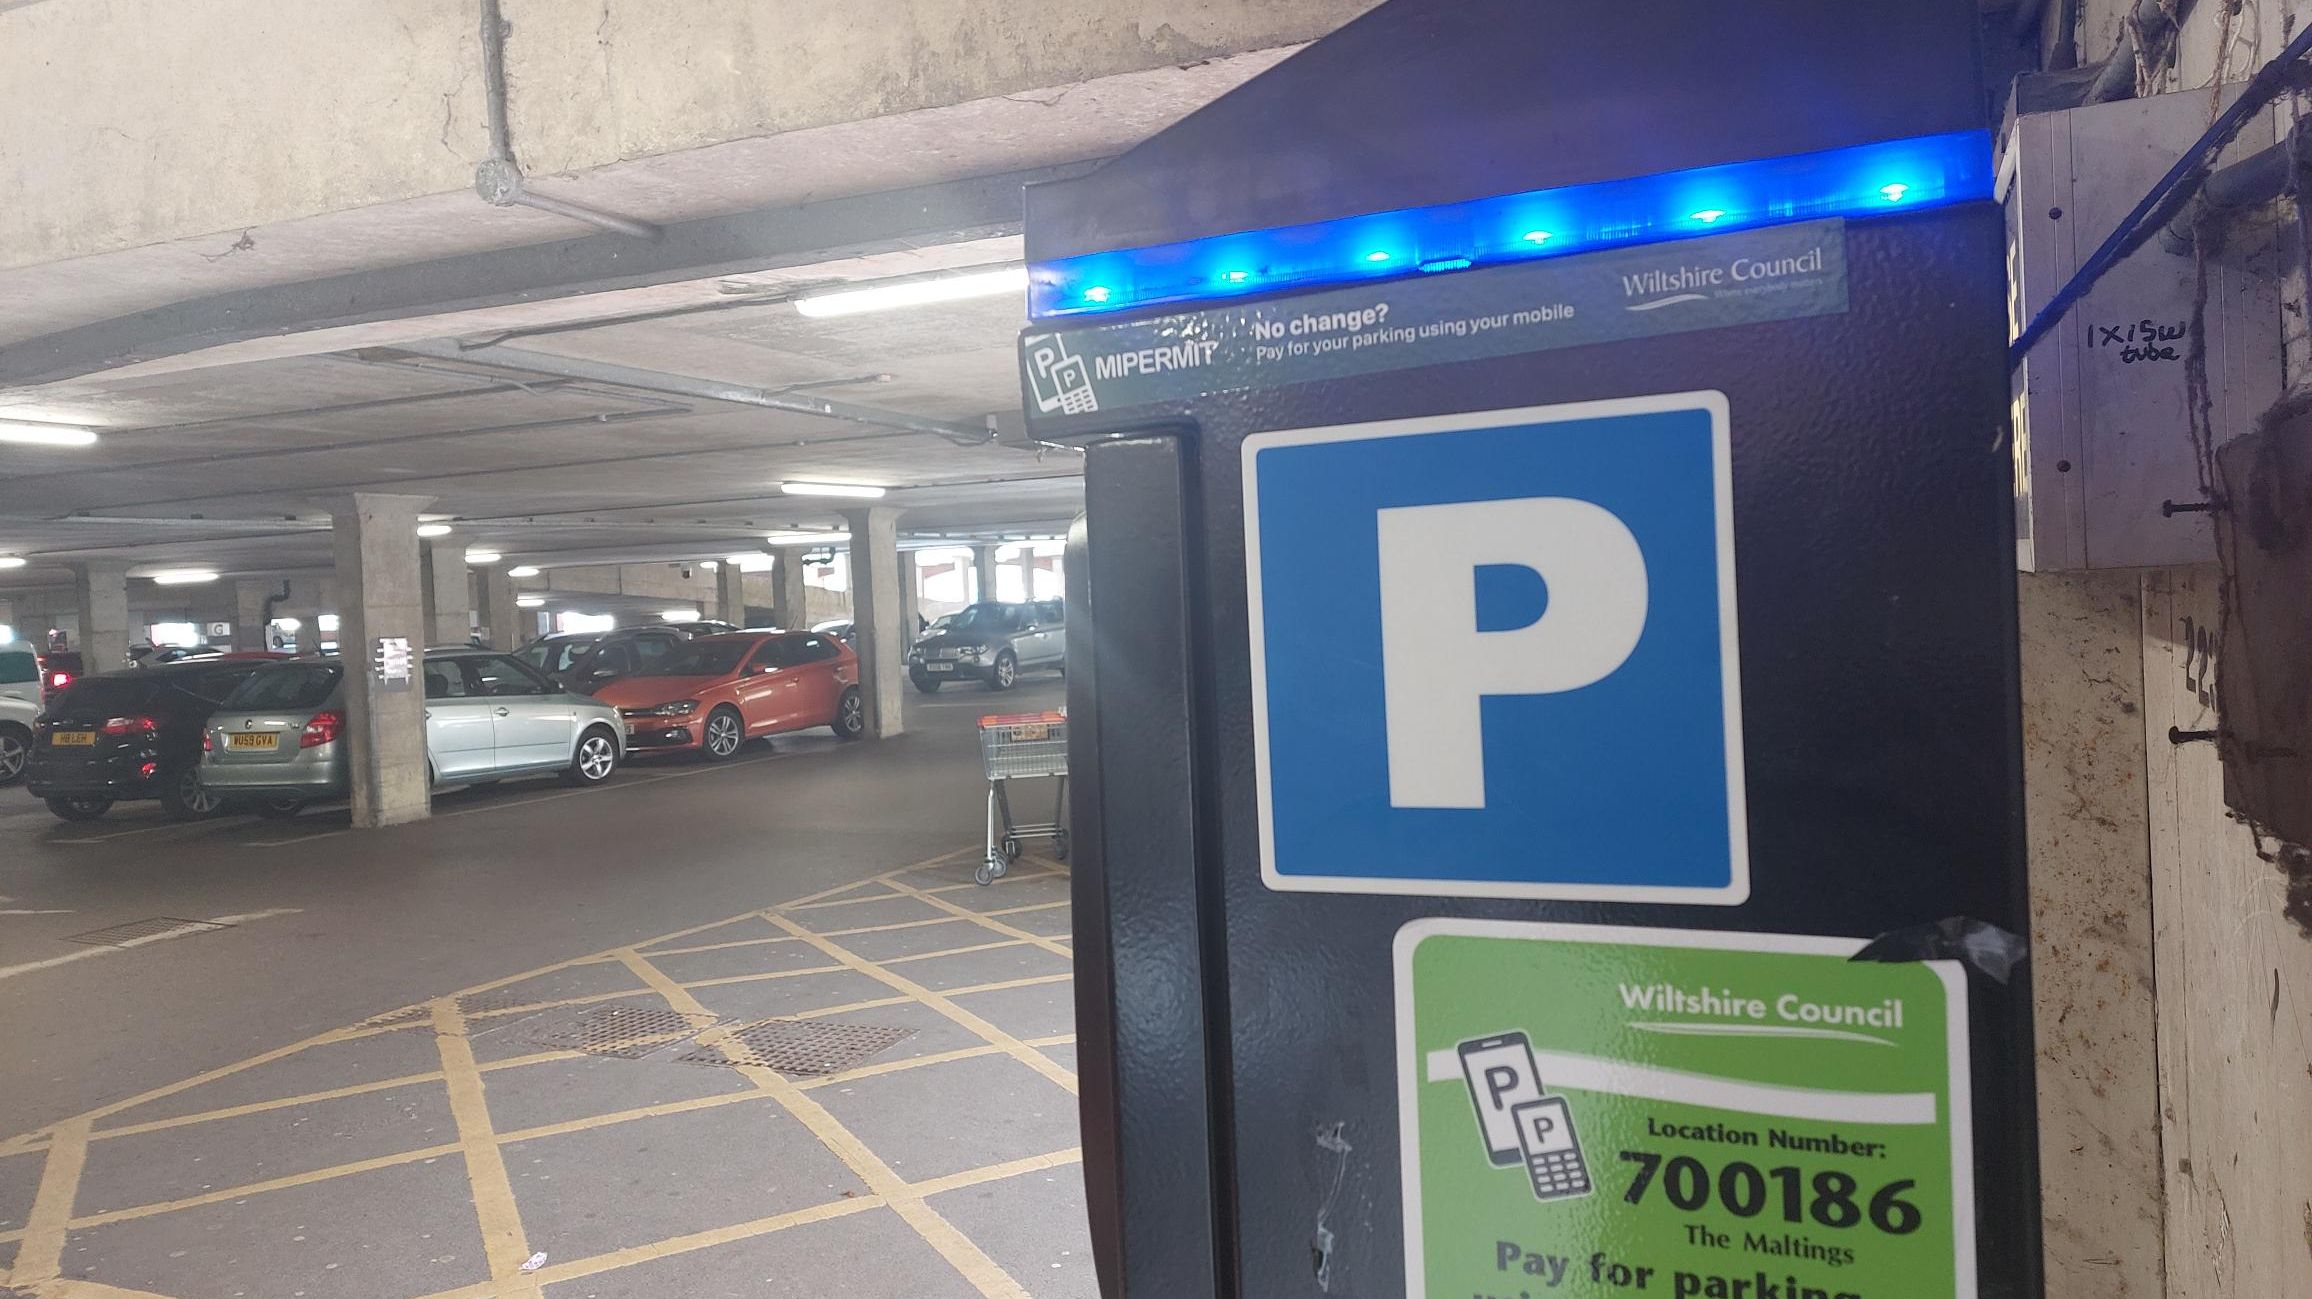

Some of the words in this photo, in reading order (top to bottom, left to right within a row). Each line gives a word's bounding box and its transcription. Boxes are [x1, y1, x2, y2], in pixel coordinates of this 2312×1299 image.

[1621, 266, 1724, 297] Wiltshire
[1730, 247, 1822, 282] Council
[1255, 320, 1286, 341] No
[1289, 302, 1390, 331] change?
[1256, 345, 1284, 361] Pay
[1288, 340, 1310, 357] for
[1312, 336, 1350, 356] your
[1352, 327, 1416, 349] parking
[1418, 319, 1467, 337] using
[1469, 313, 1510, 335] your
[1512, 303, 1575, 326] mobile
[1094, 339, 1220, 381] MIPERMIT
[2120, 342, 2181, 364] tube
[1376, 496, 1650, 810] P
[1619, 982, 1767, 1020] Wiltshire
[1775, 993, 1904, 1028] Council
[1483, 1064, 1520, 1112] P
[1532, 1116, 1556, 1145] P
[1647, 1117, 1760, 1148] Location
[1767, 1128, 1887, 1160] Number:
[1619, 1149, 1922, 1236] 700186
[1496, 1240, 1570, 1288] Pay
[1588, 1251, 1656, 1290] for
[1683, 1223, 1731, 1249] The
[1743, 1231, 1855, 1268] Maltings
